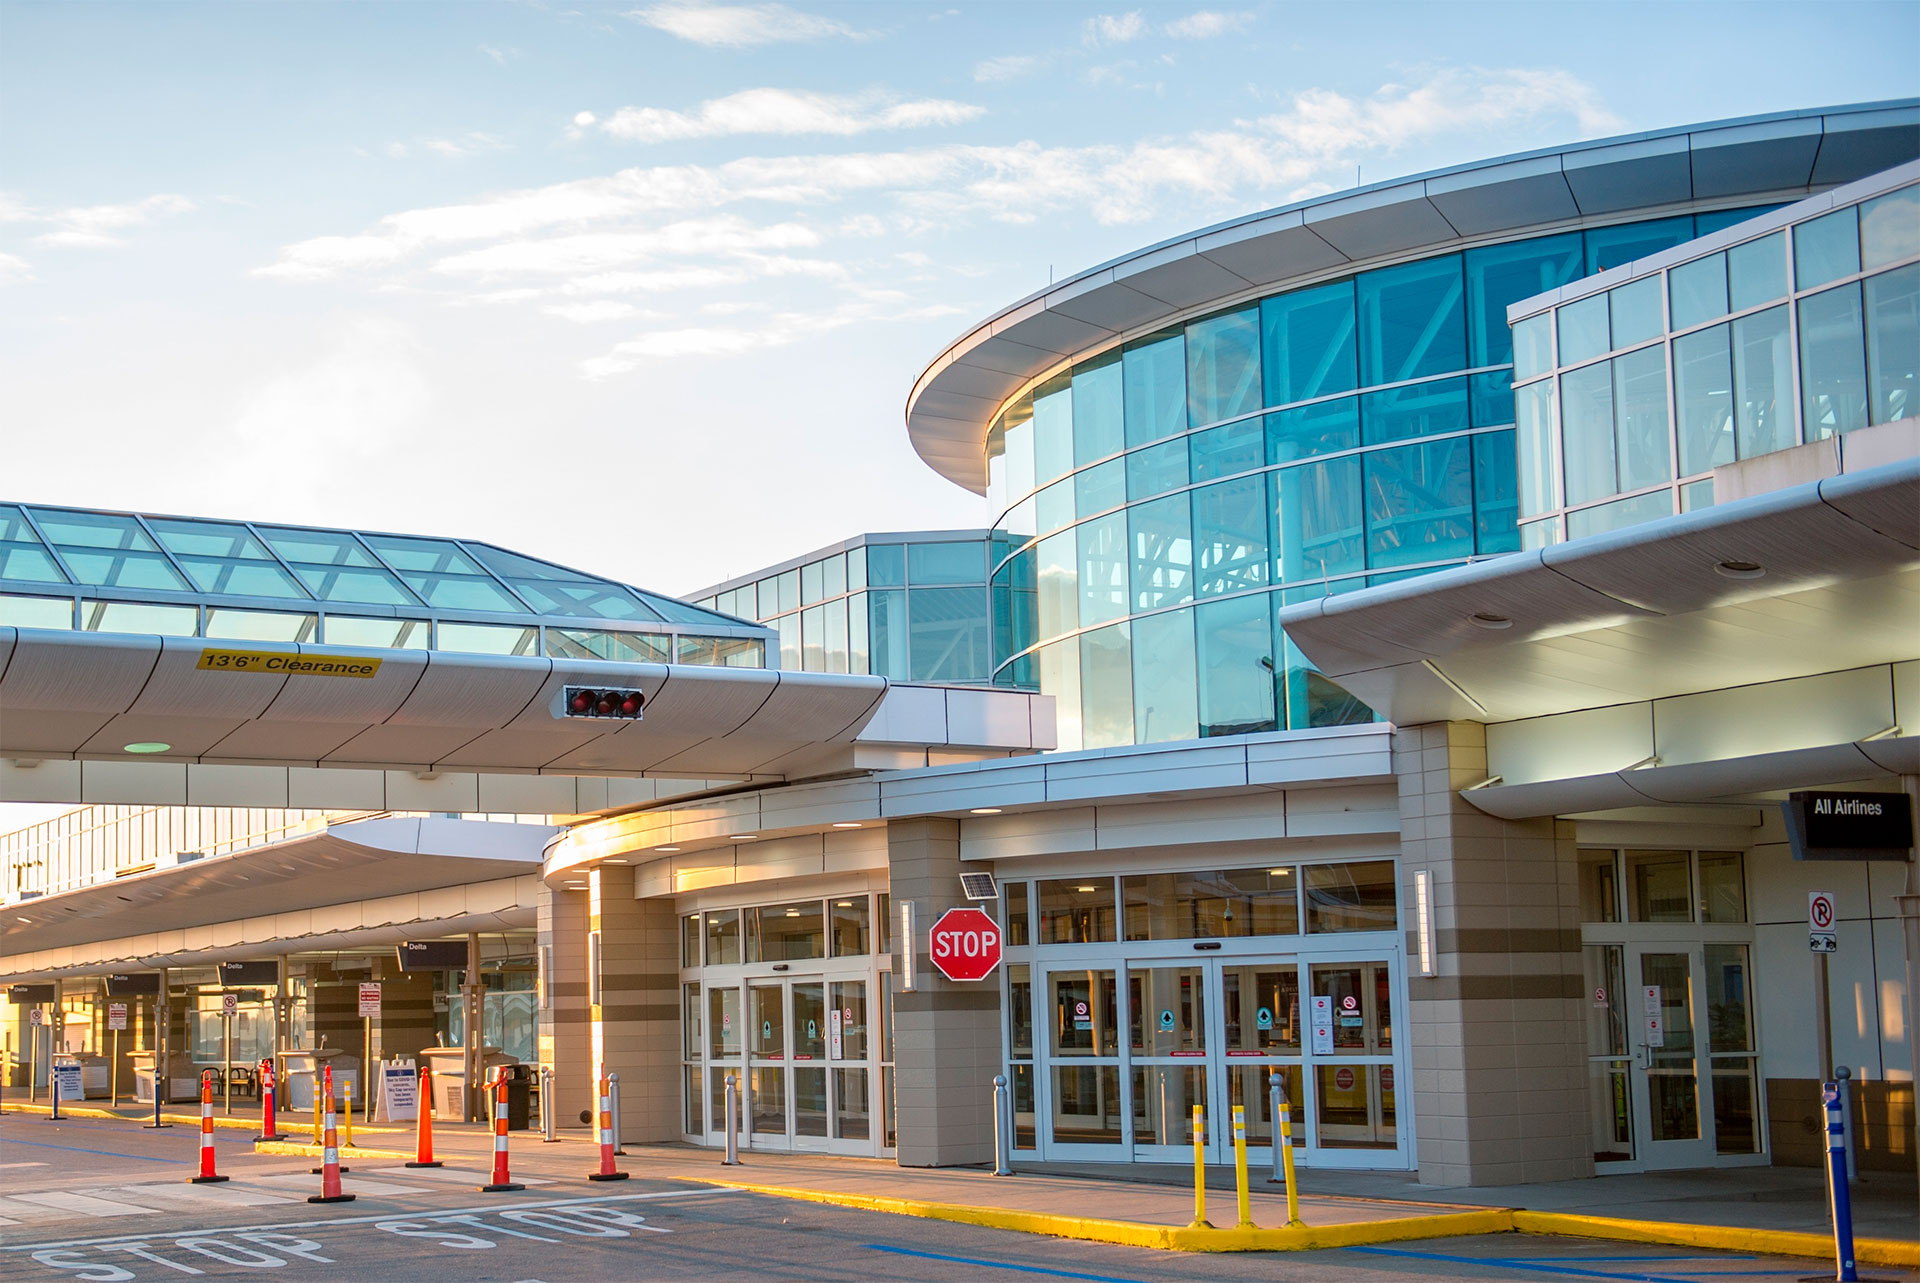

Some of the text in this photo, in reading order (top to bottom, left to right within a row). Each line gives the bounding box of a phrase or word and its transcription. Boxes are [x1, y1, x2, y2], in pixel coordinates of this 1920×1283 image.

[205, 655, 373, 674] 13'6" Clearance
[1814, 798, 1882, 815] All Airlines
[935, 930, 997, 958] STOP
[375, 1206, 675, 1249] STOP
[31, 1232, 337, 1281] STOP
